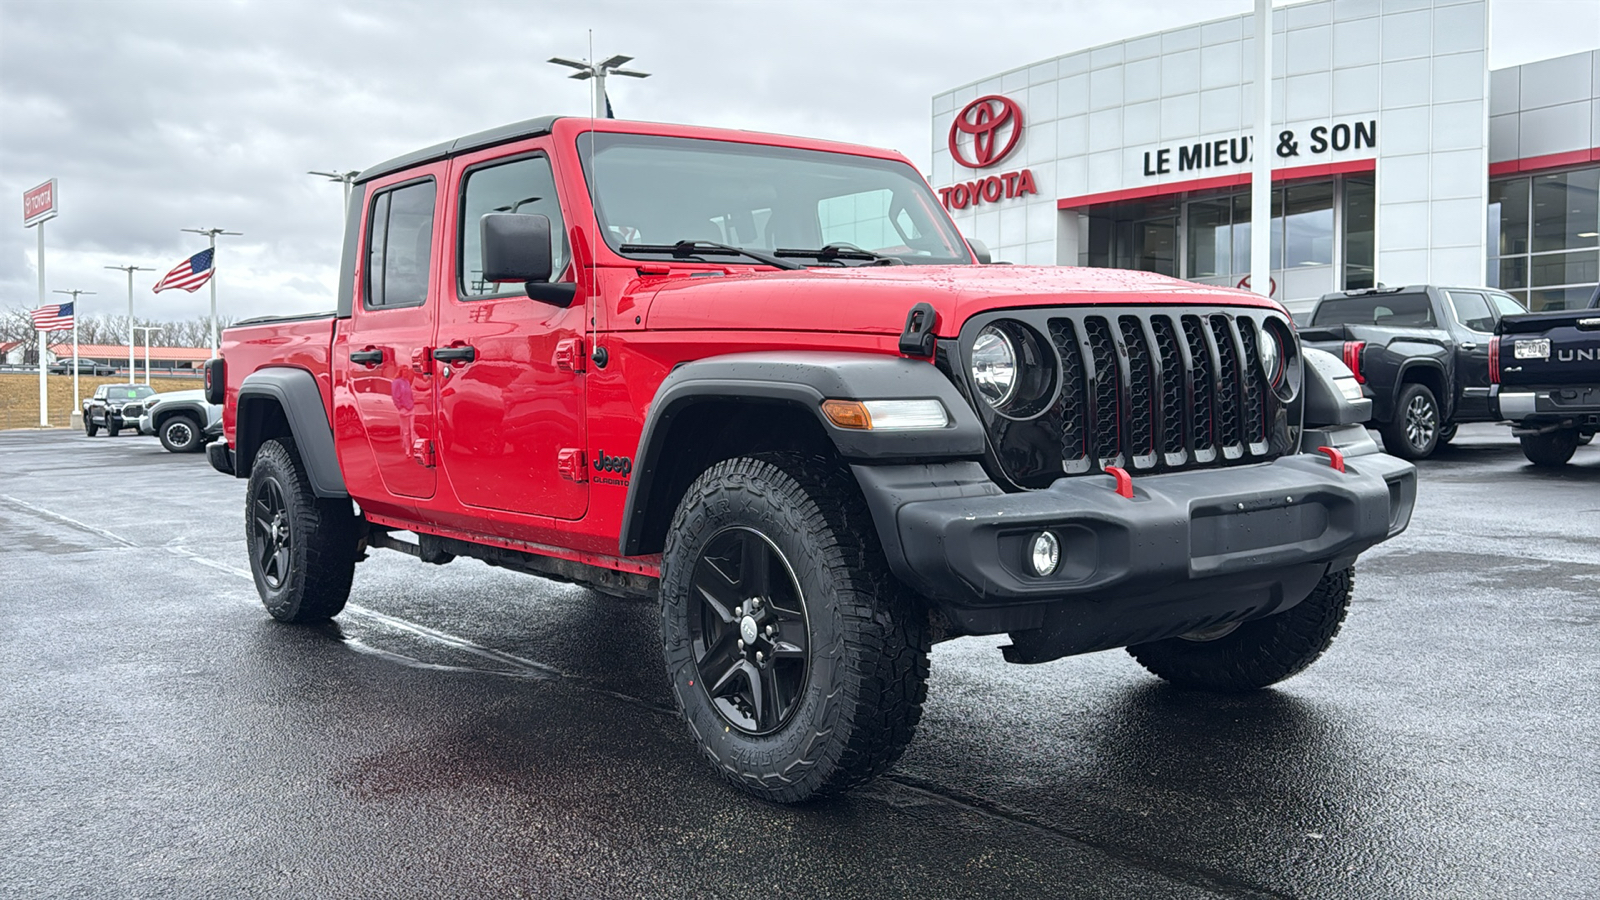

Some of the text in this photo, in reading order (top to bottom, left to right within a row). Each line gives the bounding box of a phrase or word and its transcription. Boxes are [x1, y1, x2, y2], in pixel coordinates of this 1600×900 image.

[1144, 120, 1376, 176] LE MIEU & SON
[938, 169, 1037, 210] TOYOTA
[593, 449, 631, 478] Jeep
[593, 476, 630, 487] GLADIATO
